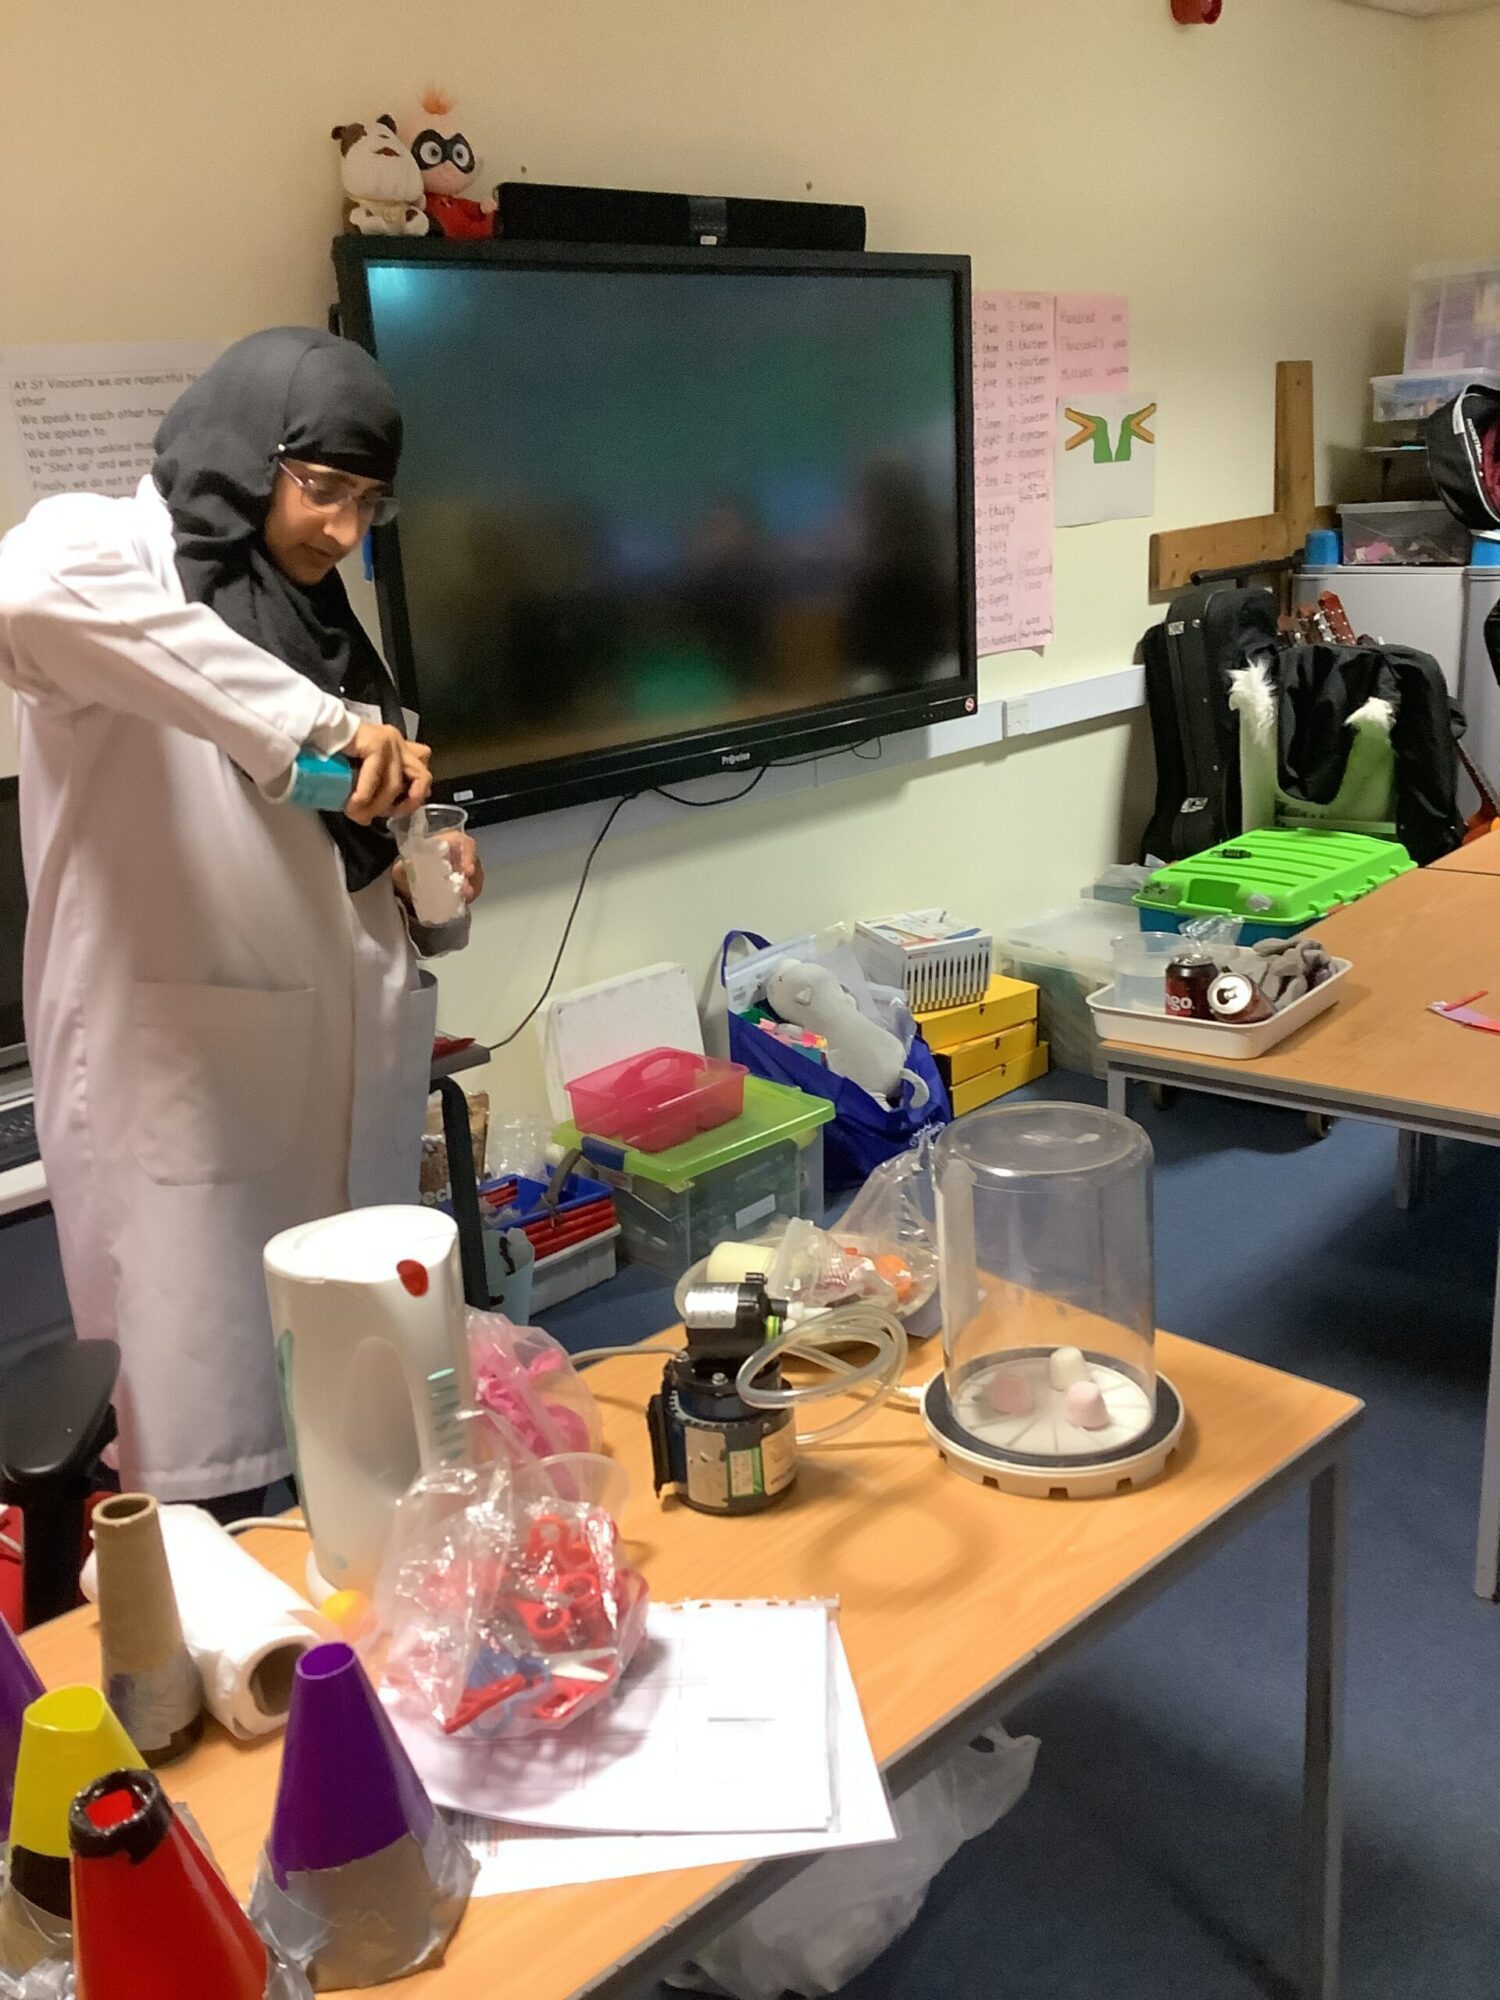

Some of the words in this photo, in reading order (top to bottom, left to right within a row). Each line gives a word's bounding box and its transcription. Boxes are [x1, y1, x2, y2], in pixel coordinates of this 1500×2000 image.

[30, 378, 43, 390] St
[97, 378, 111, 387] we
[114, 377, 131, 386] are
[41, 412, 71, 426] speak
[75, 411, 87, 422] to
[90, 410, 114, 422] each
[118, 408, 145, 420] other
[23, 431, 35, 441] to
[37, 429, 50, 441] be
[54, 427, 91, 441] spoken
